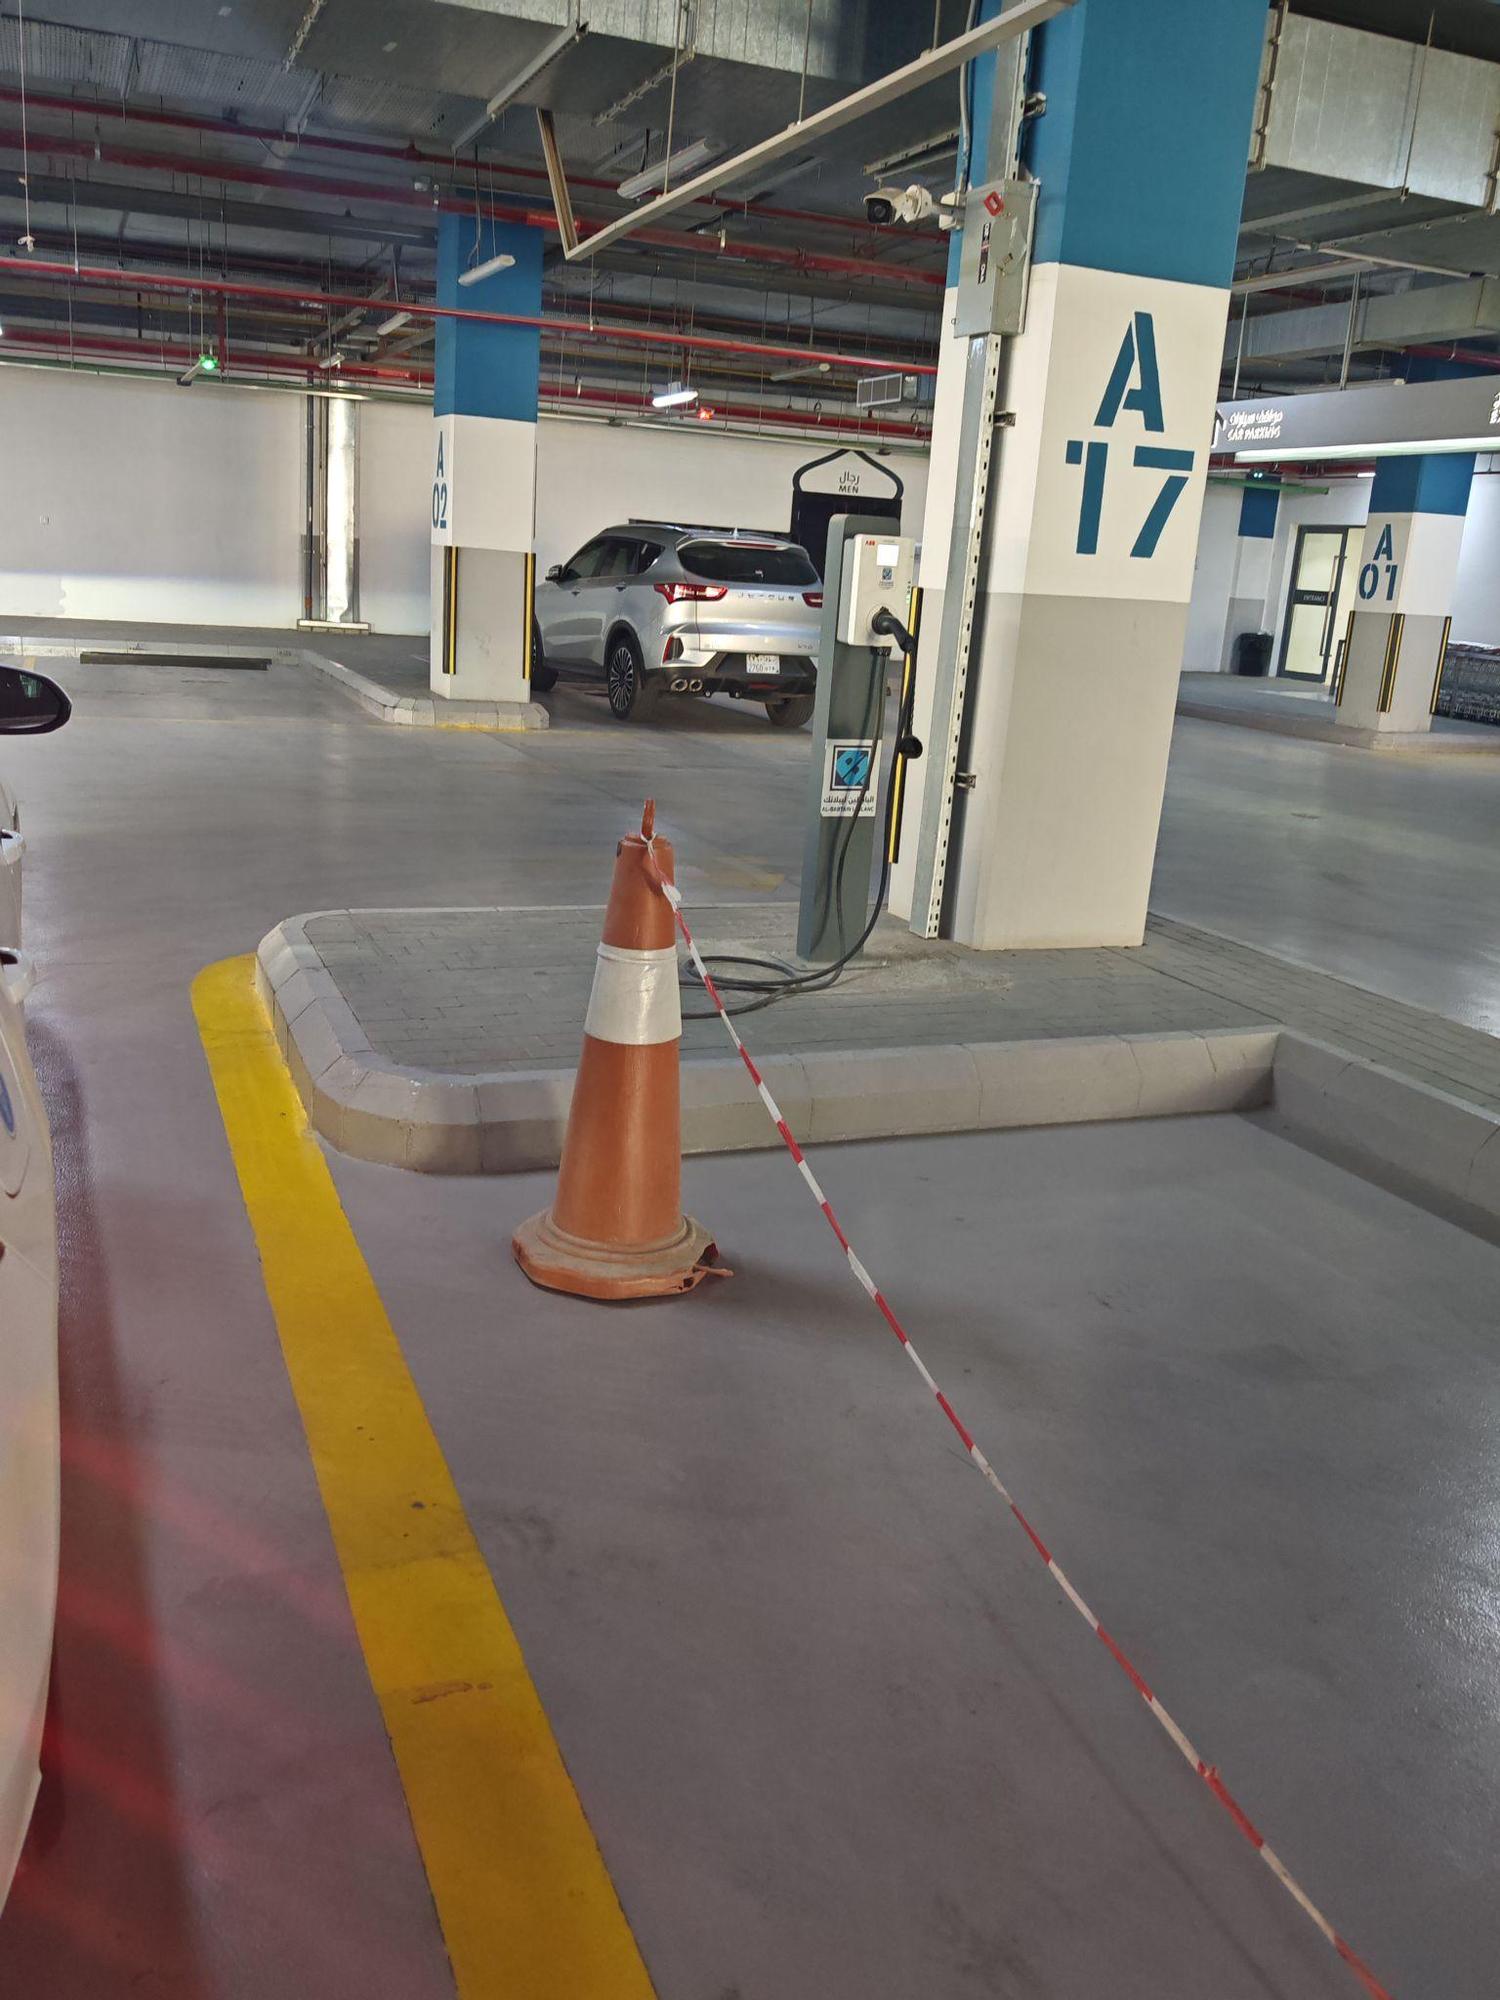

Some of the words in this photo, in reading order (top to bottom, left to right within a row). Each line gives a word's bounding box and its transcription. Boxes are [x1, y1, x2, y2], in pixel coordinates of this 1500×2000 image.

[1093, 311, 1165, 433] A
[1228, 428, 1244, 441] CAR
[1244, 425, 1281, 440] PARKING
[436, 430, 444, 478] A
[838, 485, 860, 495] MEN
[839, 471, 860, 486] رجال
[432, 482, 448, 529] 02
[1065, 440, 1196, 559] 17
[1373, 524, 1393, 561] A
[1359, 563, 1398, 601] 01
